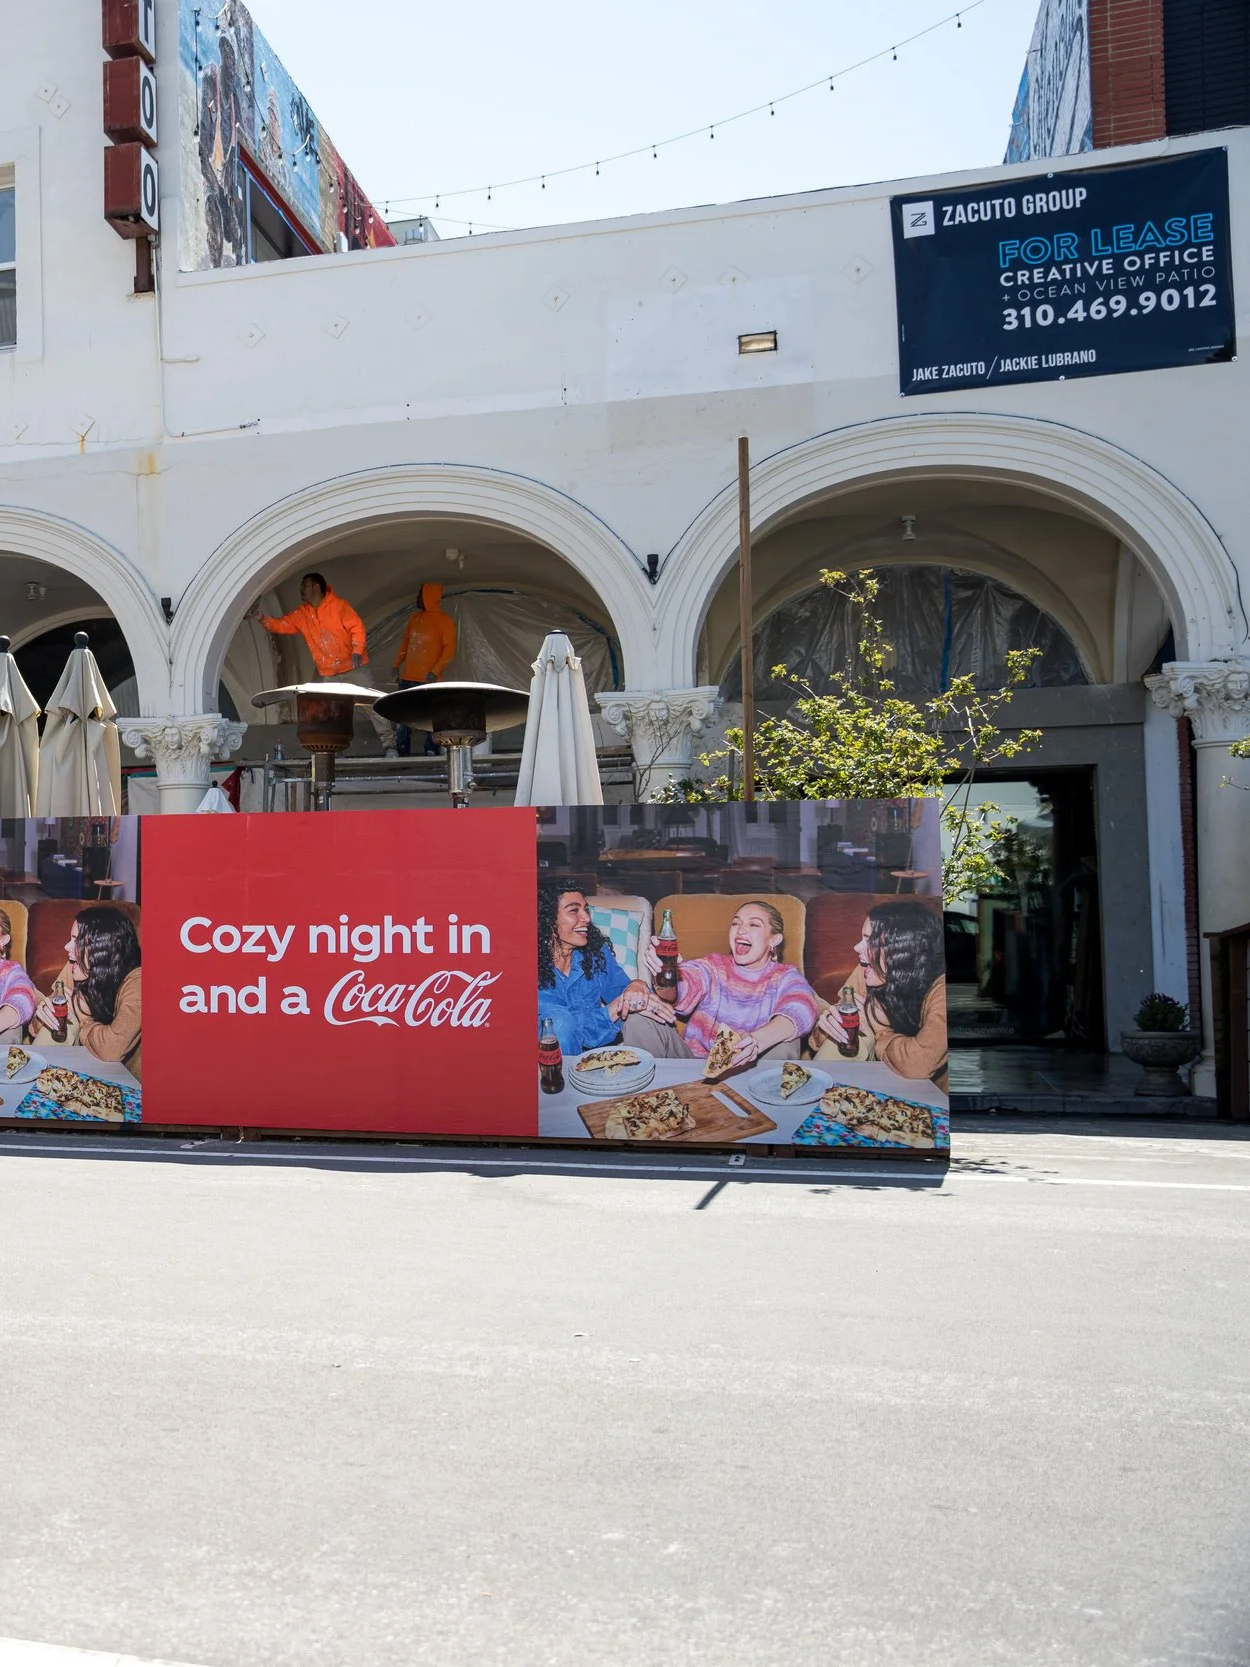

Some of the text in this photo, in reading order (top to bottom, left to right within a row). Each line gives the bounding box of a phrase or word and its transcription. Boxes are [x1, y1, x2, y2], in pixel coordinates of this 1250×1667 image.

[942, 187, 1088, 227] ZACUTO GROUP
[999, 213, 1214, 268] FOR LEASE
[1000, 245, 1215, 287] CREATIVE OFFICE
[1018, 282, 1086, 302] OCEAN
[1096, 274, 1145, 292] VIEW
[1156, 266, 1215, 285] PATIO
[1002, 284, 1217, 331] 310.469.9012
[912, 366, 939, 382] JAKE
[942, 361, 985, 379] ZACUTO
[999, 355, 1039, 373] JACKIE
[1042, 349, 1097, 368] LUBRANO
[179, 913, 491, 963] Cozy night in
[179, 969, 503, 1028] and a Coca-Cola
